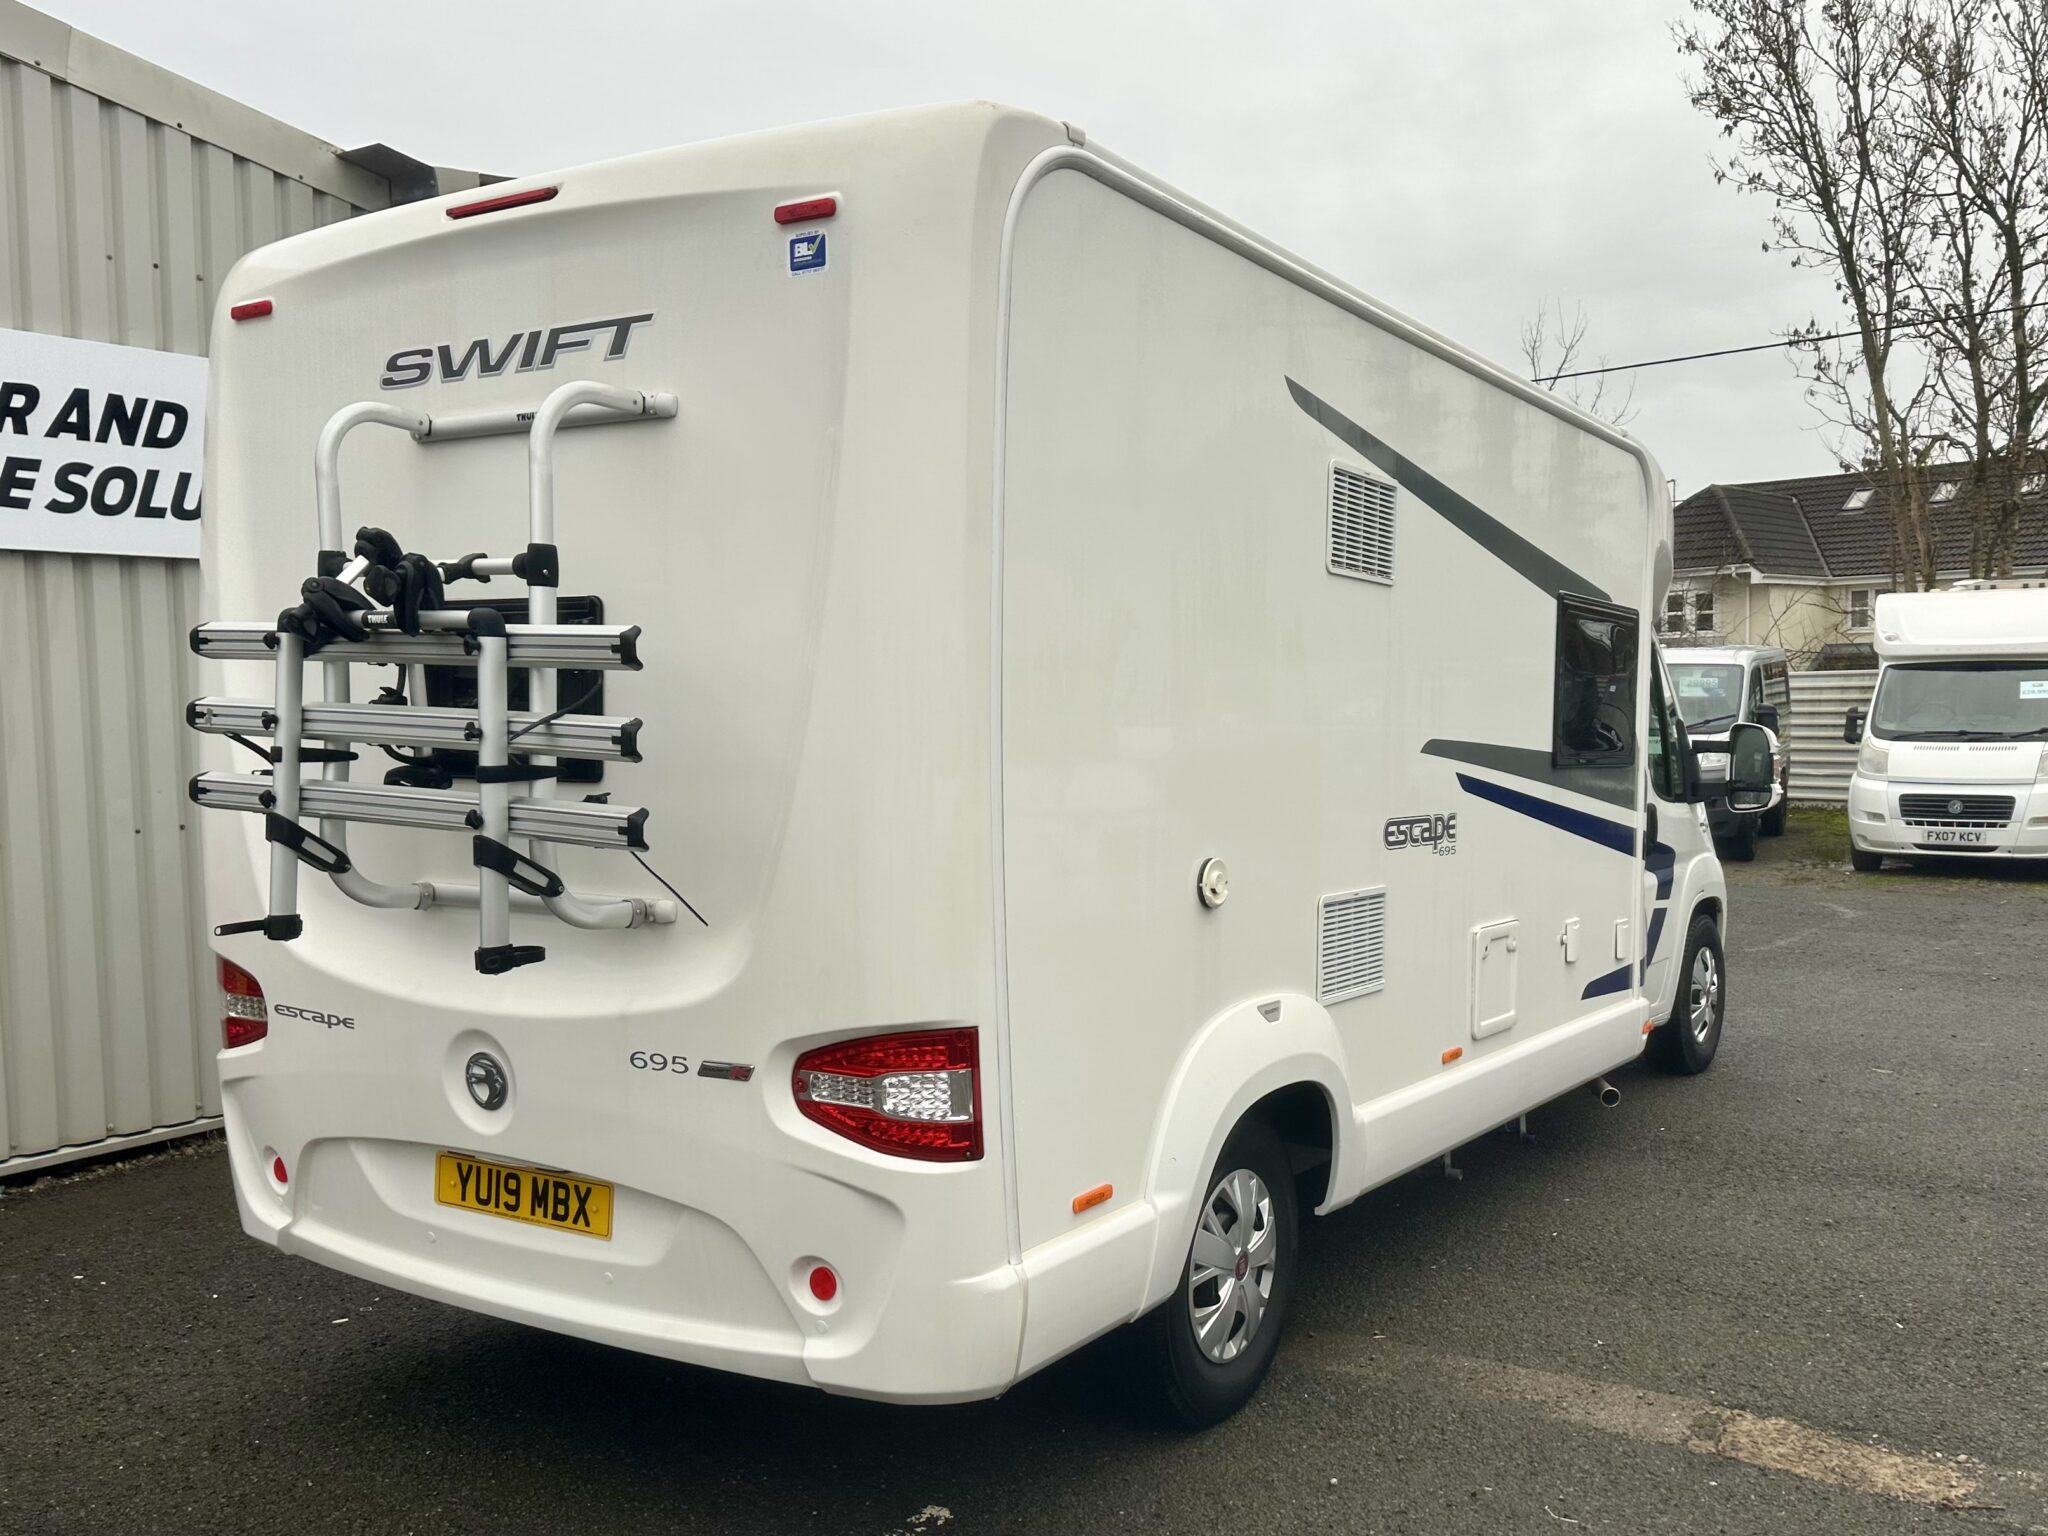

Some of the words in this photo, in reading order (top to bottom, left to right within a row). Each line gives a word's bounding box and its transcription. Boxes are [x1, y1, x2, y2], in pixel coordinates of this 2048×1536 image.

[380, 312, 655, 391] SWIFT
[0, 381, 41, 436] R
[43, 387, 189, 449] AND
[0, 456, 43, 510] E
[44, 461, 202, 521] SOLU
[367, 614, 388, 624] THULE
[1439, 846, 1456, 856] 695
[1927, 831, 1956, 841] FX07
[1959, 832, 1982, 842] KCV
[630, 1051, 689, 1074] 695
[456, 1162, 521, 1213] YU19
[530, 1176, 592, 1228] MBX
